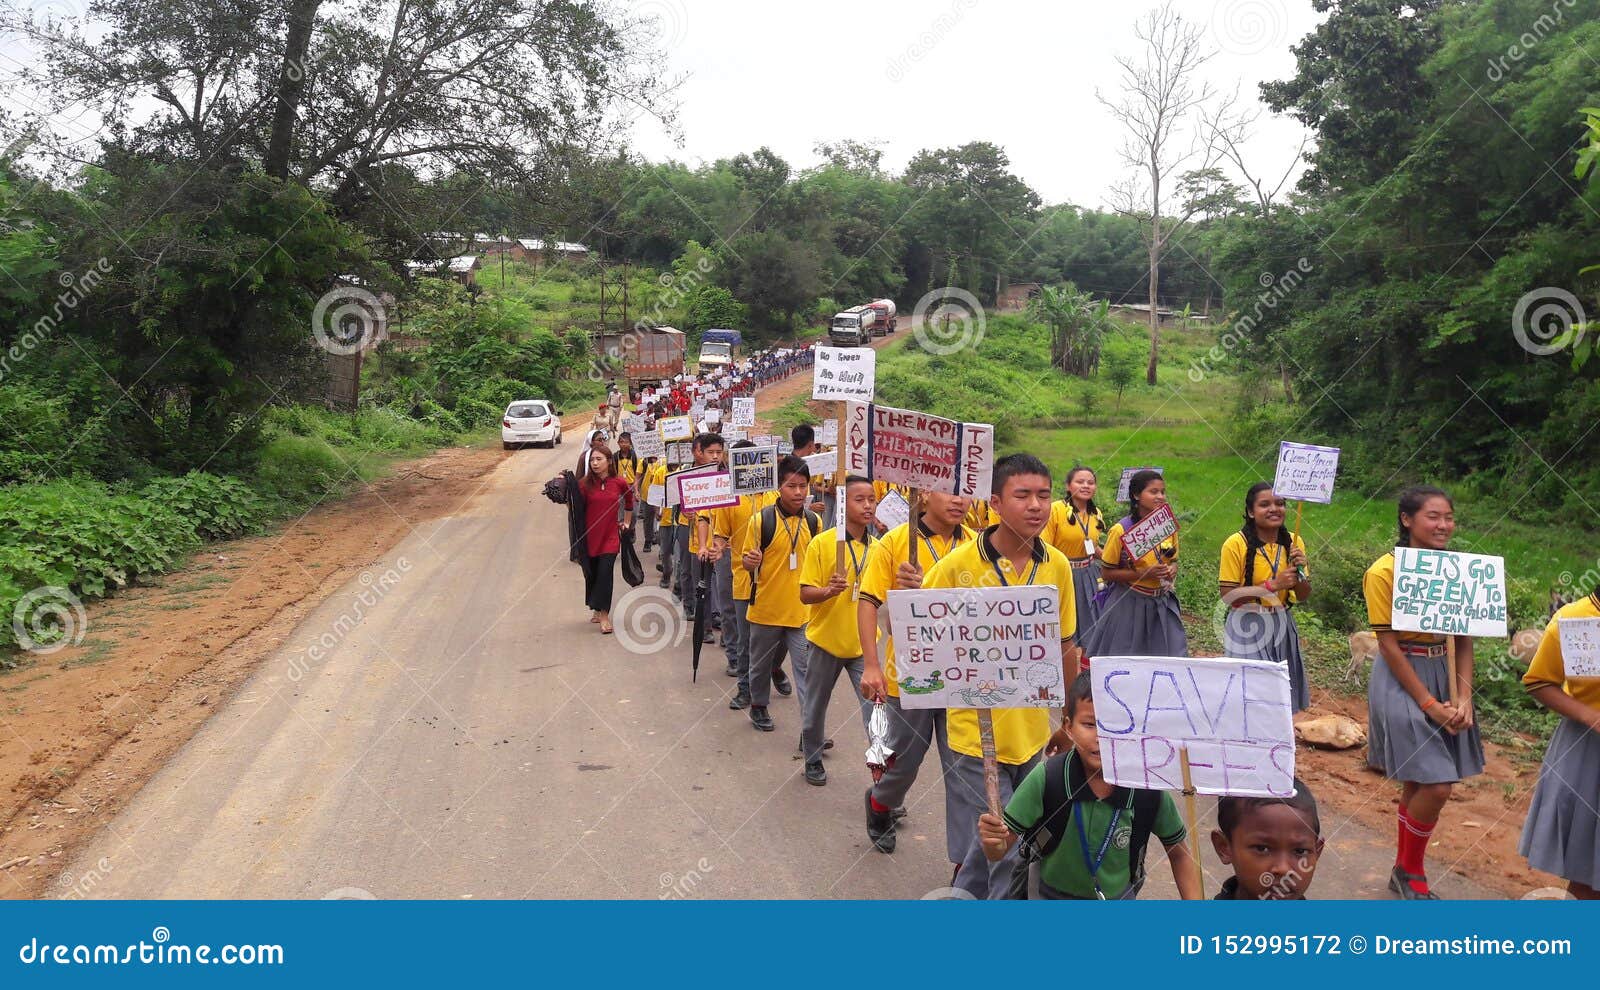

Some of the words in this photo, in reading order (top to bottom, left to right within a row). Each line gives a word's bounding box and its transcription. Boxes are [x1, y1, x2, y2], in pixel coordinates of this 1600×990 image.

[876, 409, 956, 440] THENGPI
[850, 406, 865, 470] SAVE
[734, 452, 769, 466] LOVE
[685, 481, 710, 492] Save
[1400, 549, 1460, 583] LETS
[1468, 559, 1496, 584] GO
[1398, 575, 1478, 605] GREEN
[910, 602, 978, 619] LOVE
[985, 598, 1054, 616] YOUR
[1394, 596, 1437, 616] GET
[1439, 603, 1462, 615] OUR
[1464, 603, 1506, 621] GLOBE
[907, 622, 1059, 642] ENVIRONMENT
[1420, 613, 1470, 633] CLEAN
[910, 647, 933, 663] BE
[955, 645, 1046, 662] PROUD
[945, 667, 979, 682] OF
[1097, 665, 1291, 744] SAVE
[1097, 735, 1295, 798] TREES
